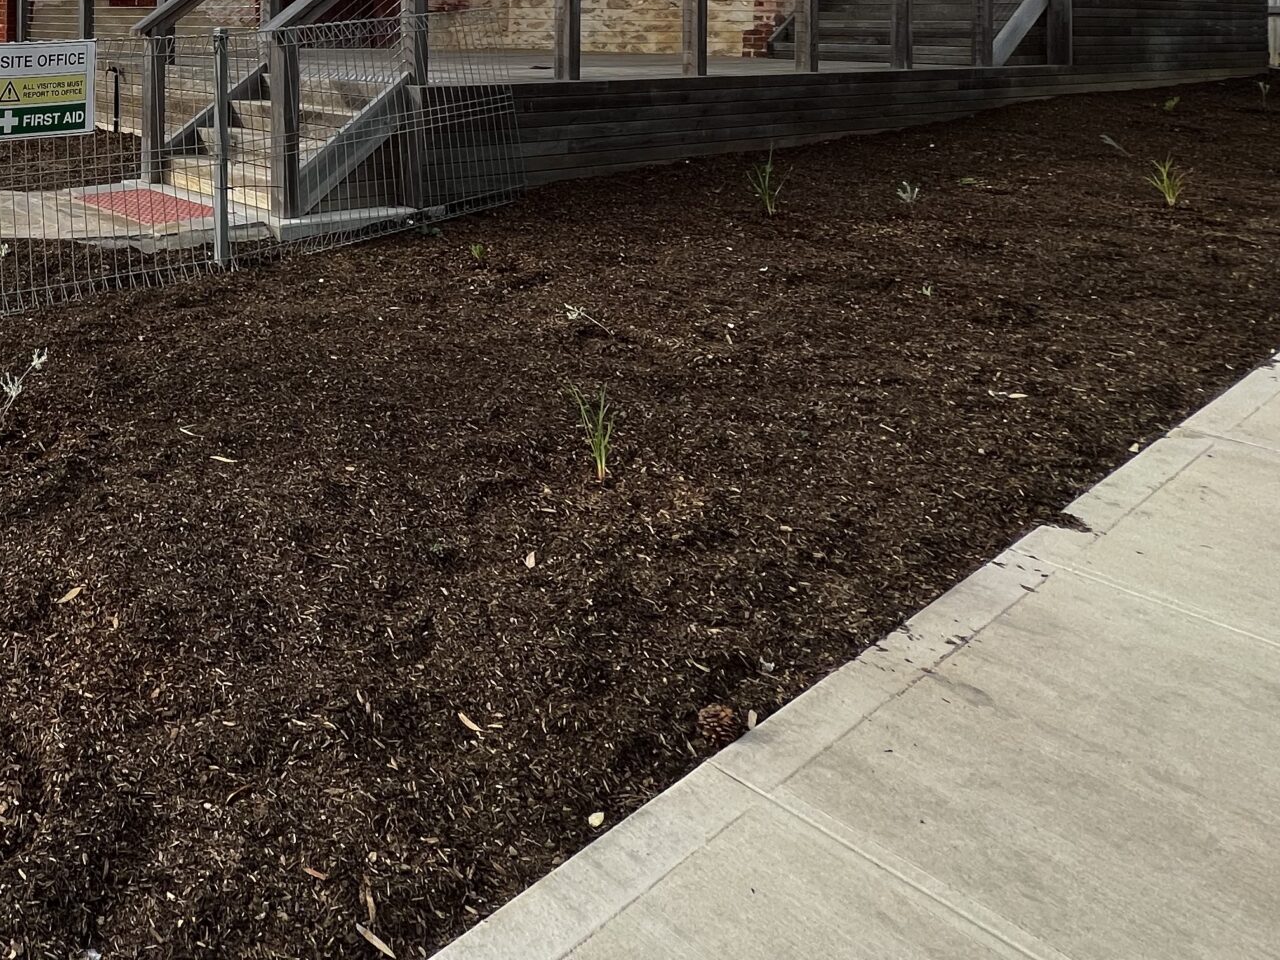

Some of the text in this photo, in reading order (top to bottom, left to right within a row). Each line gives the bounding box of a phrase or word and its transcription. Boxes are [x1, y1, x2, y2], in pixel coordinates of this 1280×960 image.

[0, 52, 85, 68] SITE OFFICE
[37, 81, 65, 90] VISITORS
[67, 80, 83, 88] MUST
[23, 90, 49, 98] REPORT
[61, 88, 82, 96] OFFICE
[23, 110, 84, 127] FIRST AID
